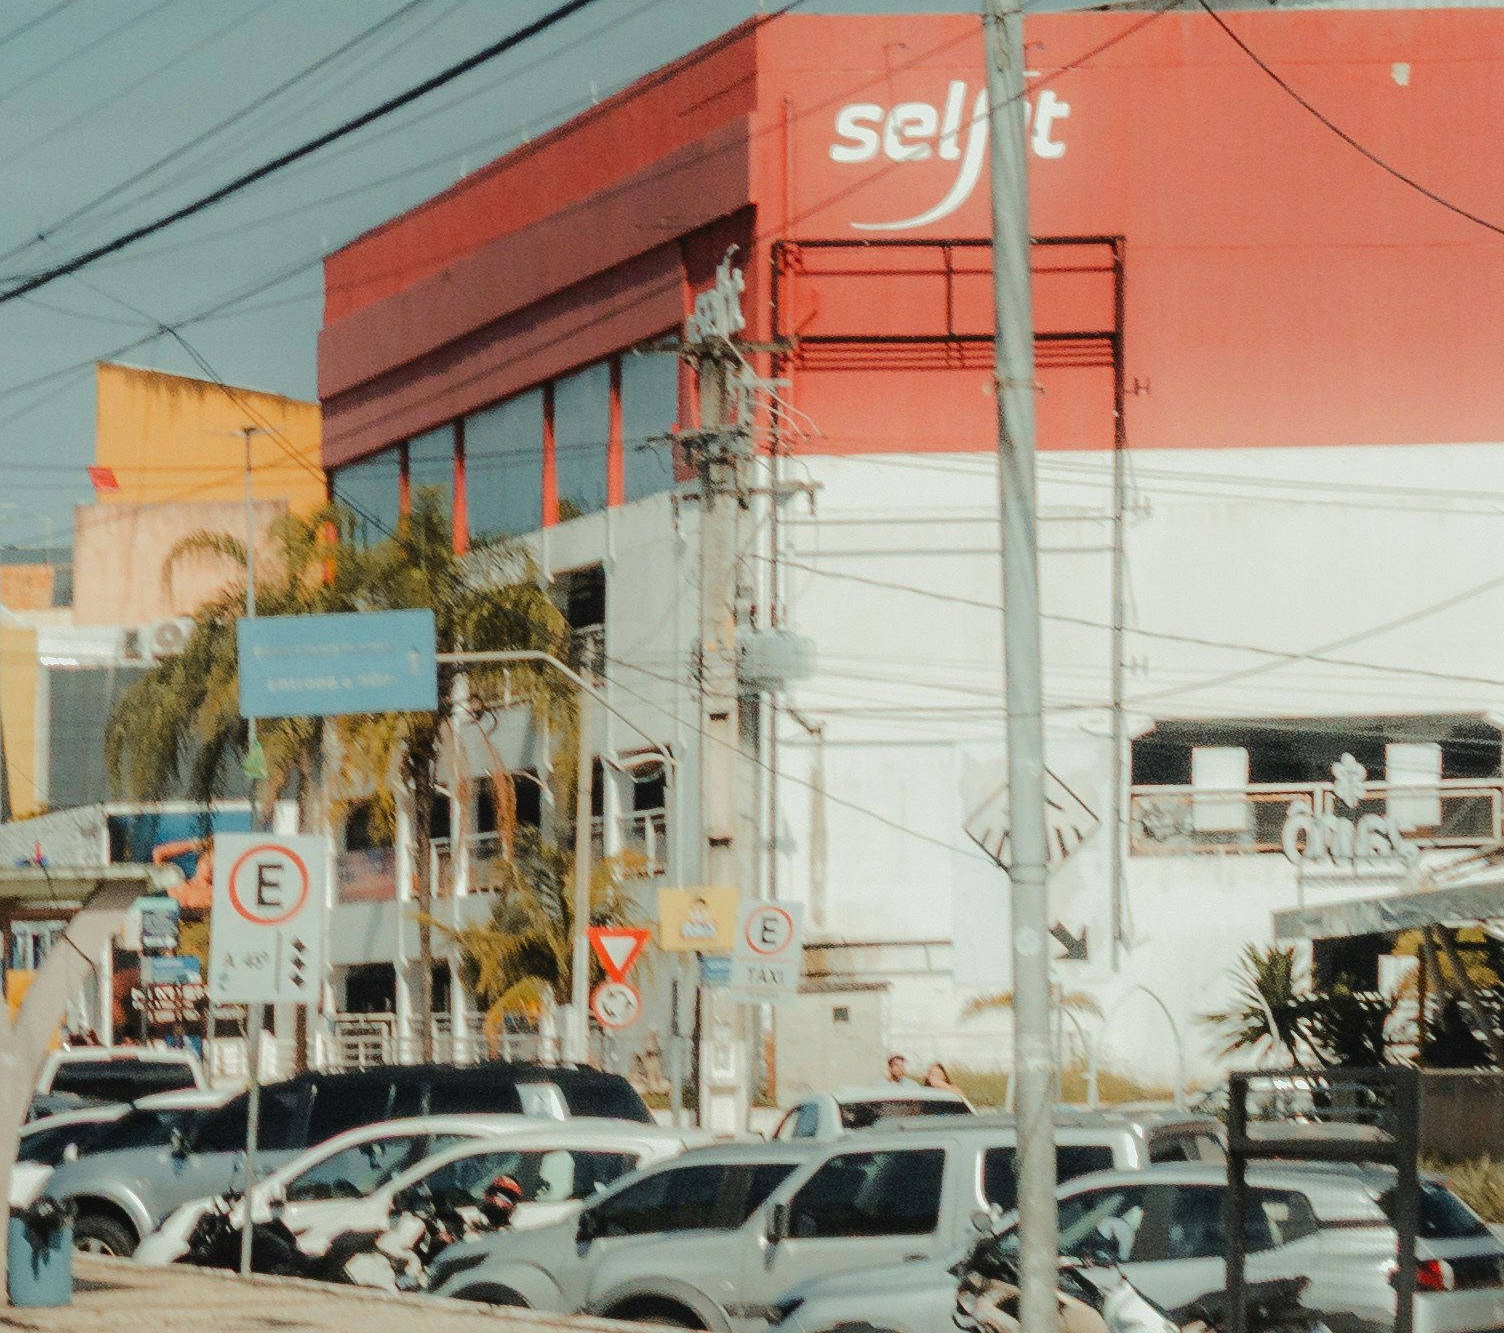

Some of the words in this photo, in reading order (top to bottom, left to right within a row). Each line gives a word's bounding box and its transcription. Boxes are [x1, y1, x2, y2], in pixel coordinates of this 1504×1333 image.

[257, 864, 283, 907] E
[761, 916, 778, 944] E
[747, 966, 784, 984] TAXI
